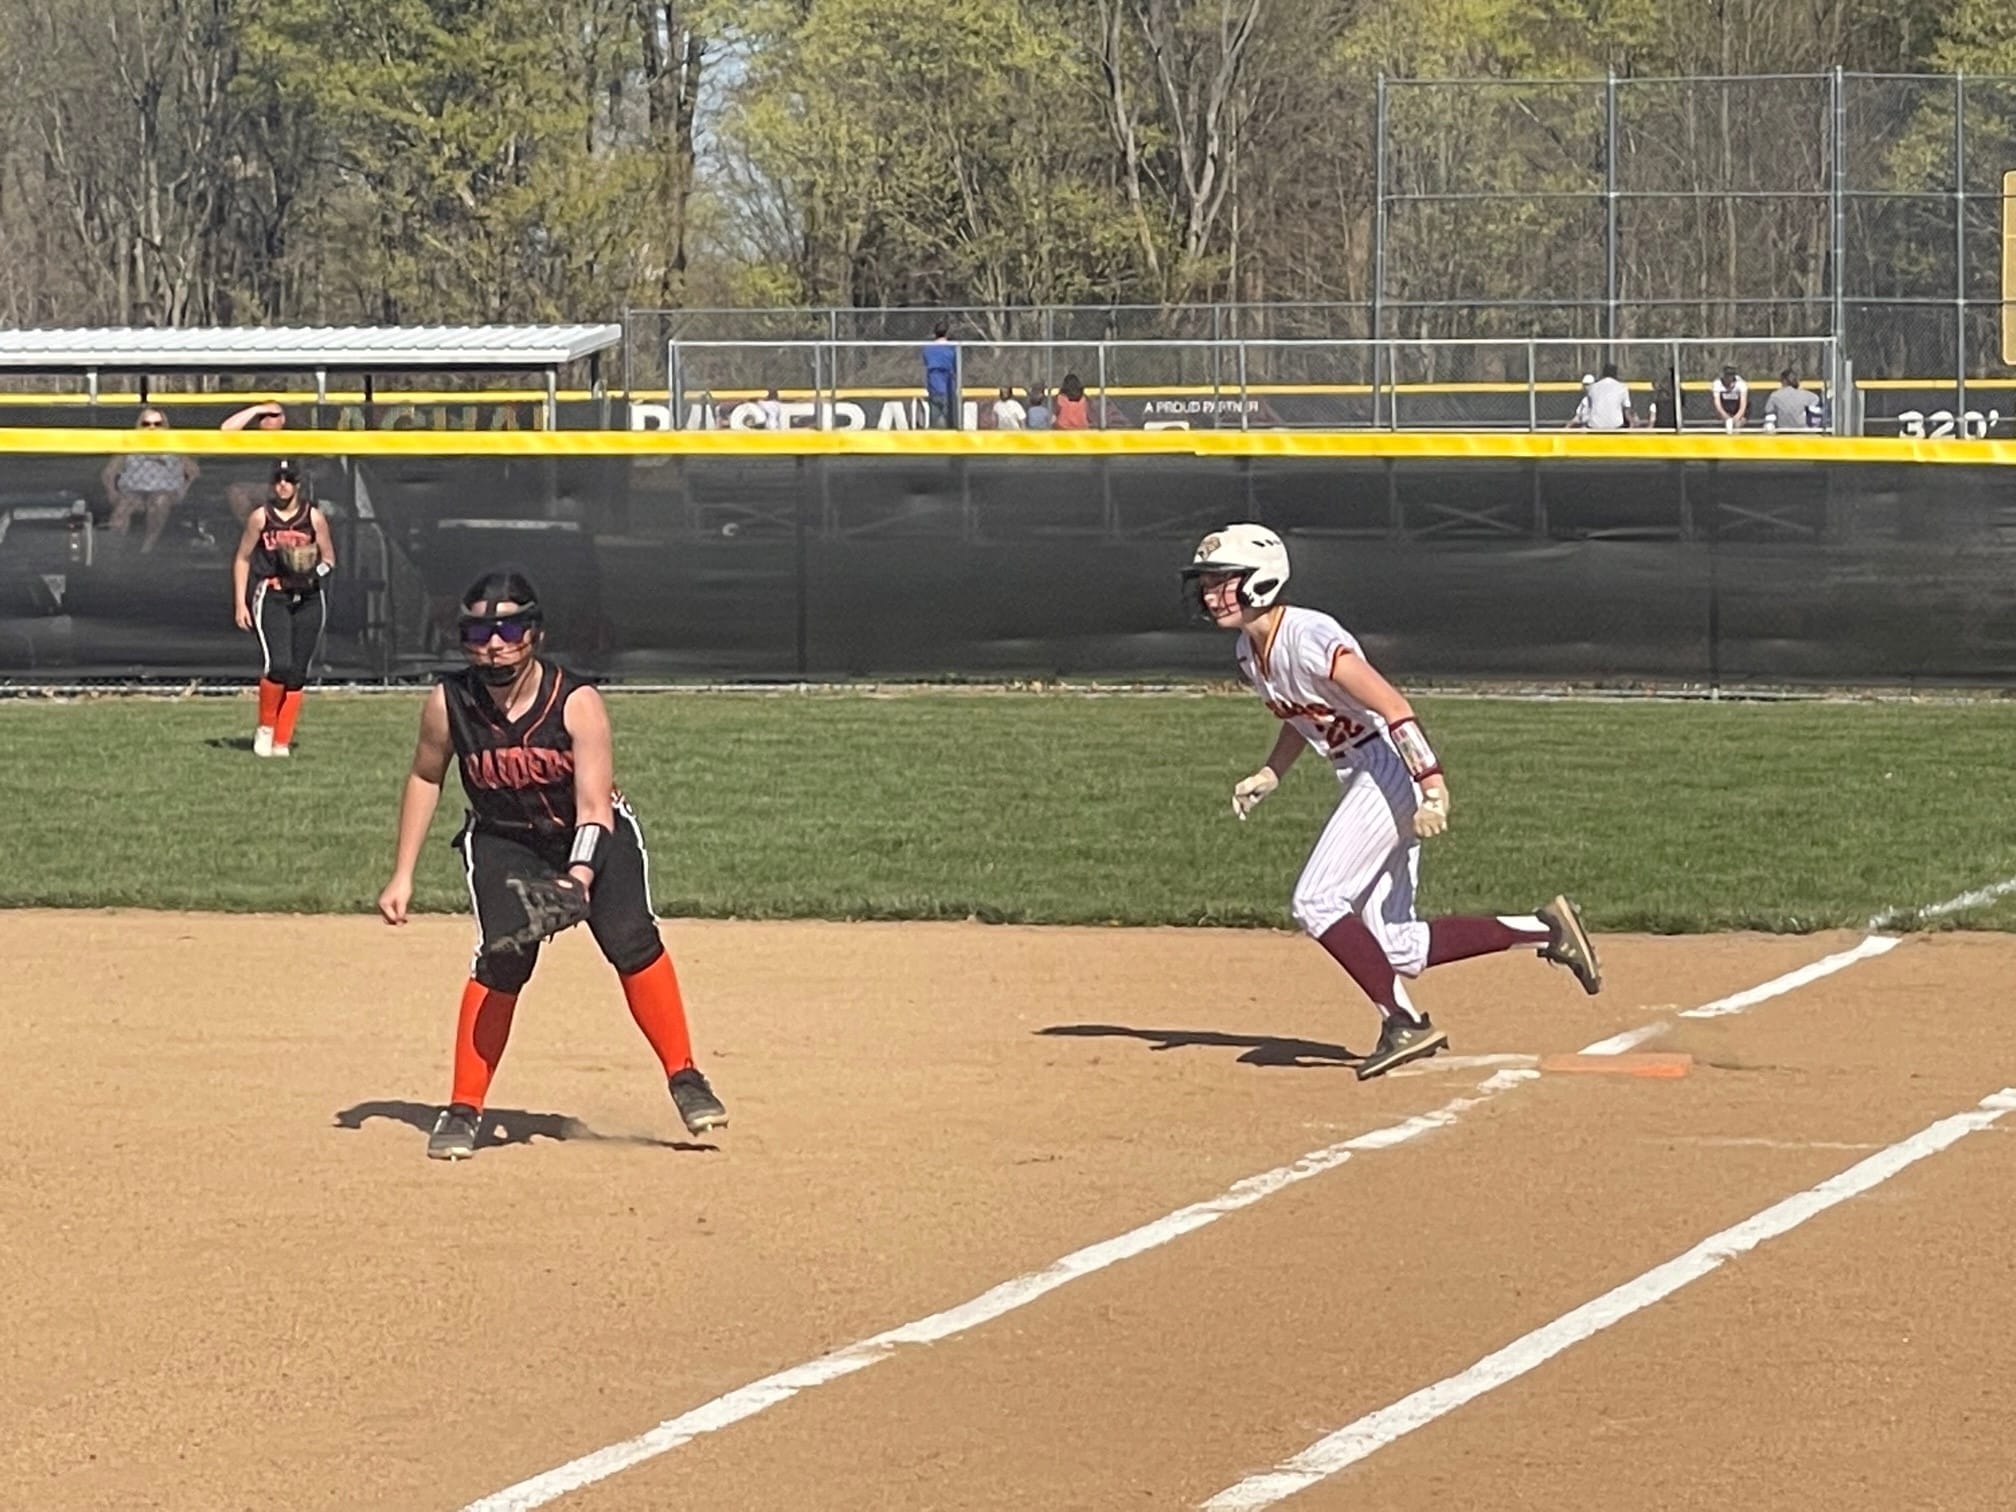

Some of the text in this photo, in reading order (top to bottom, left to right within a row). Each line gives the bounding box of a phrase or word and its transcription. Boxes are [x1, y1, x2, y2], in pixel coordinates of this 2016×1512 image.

[1144, 401, 1259, 413] A PROUD PARTNR
